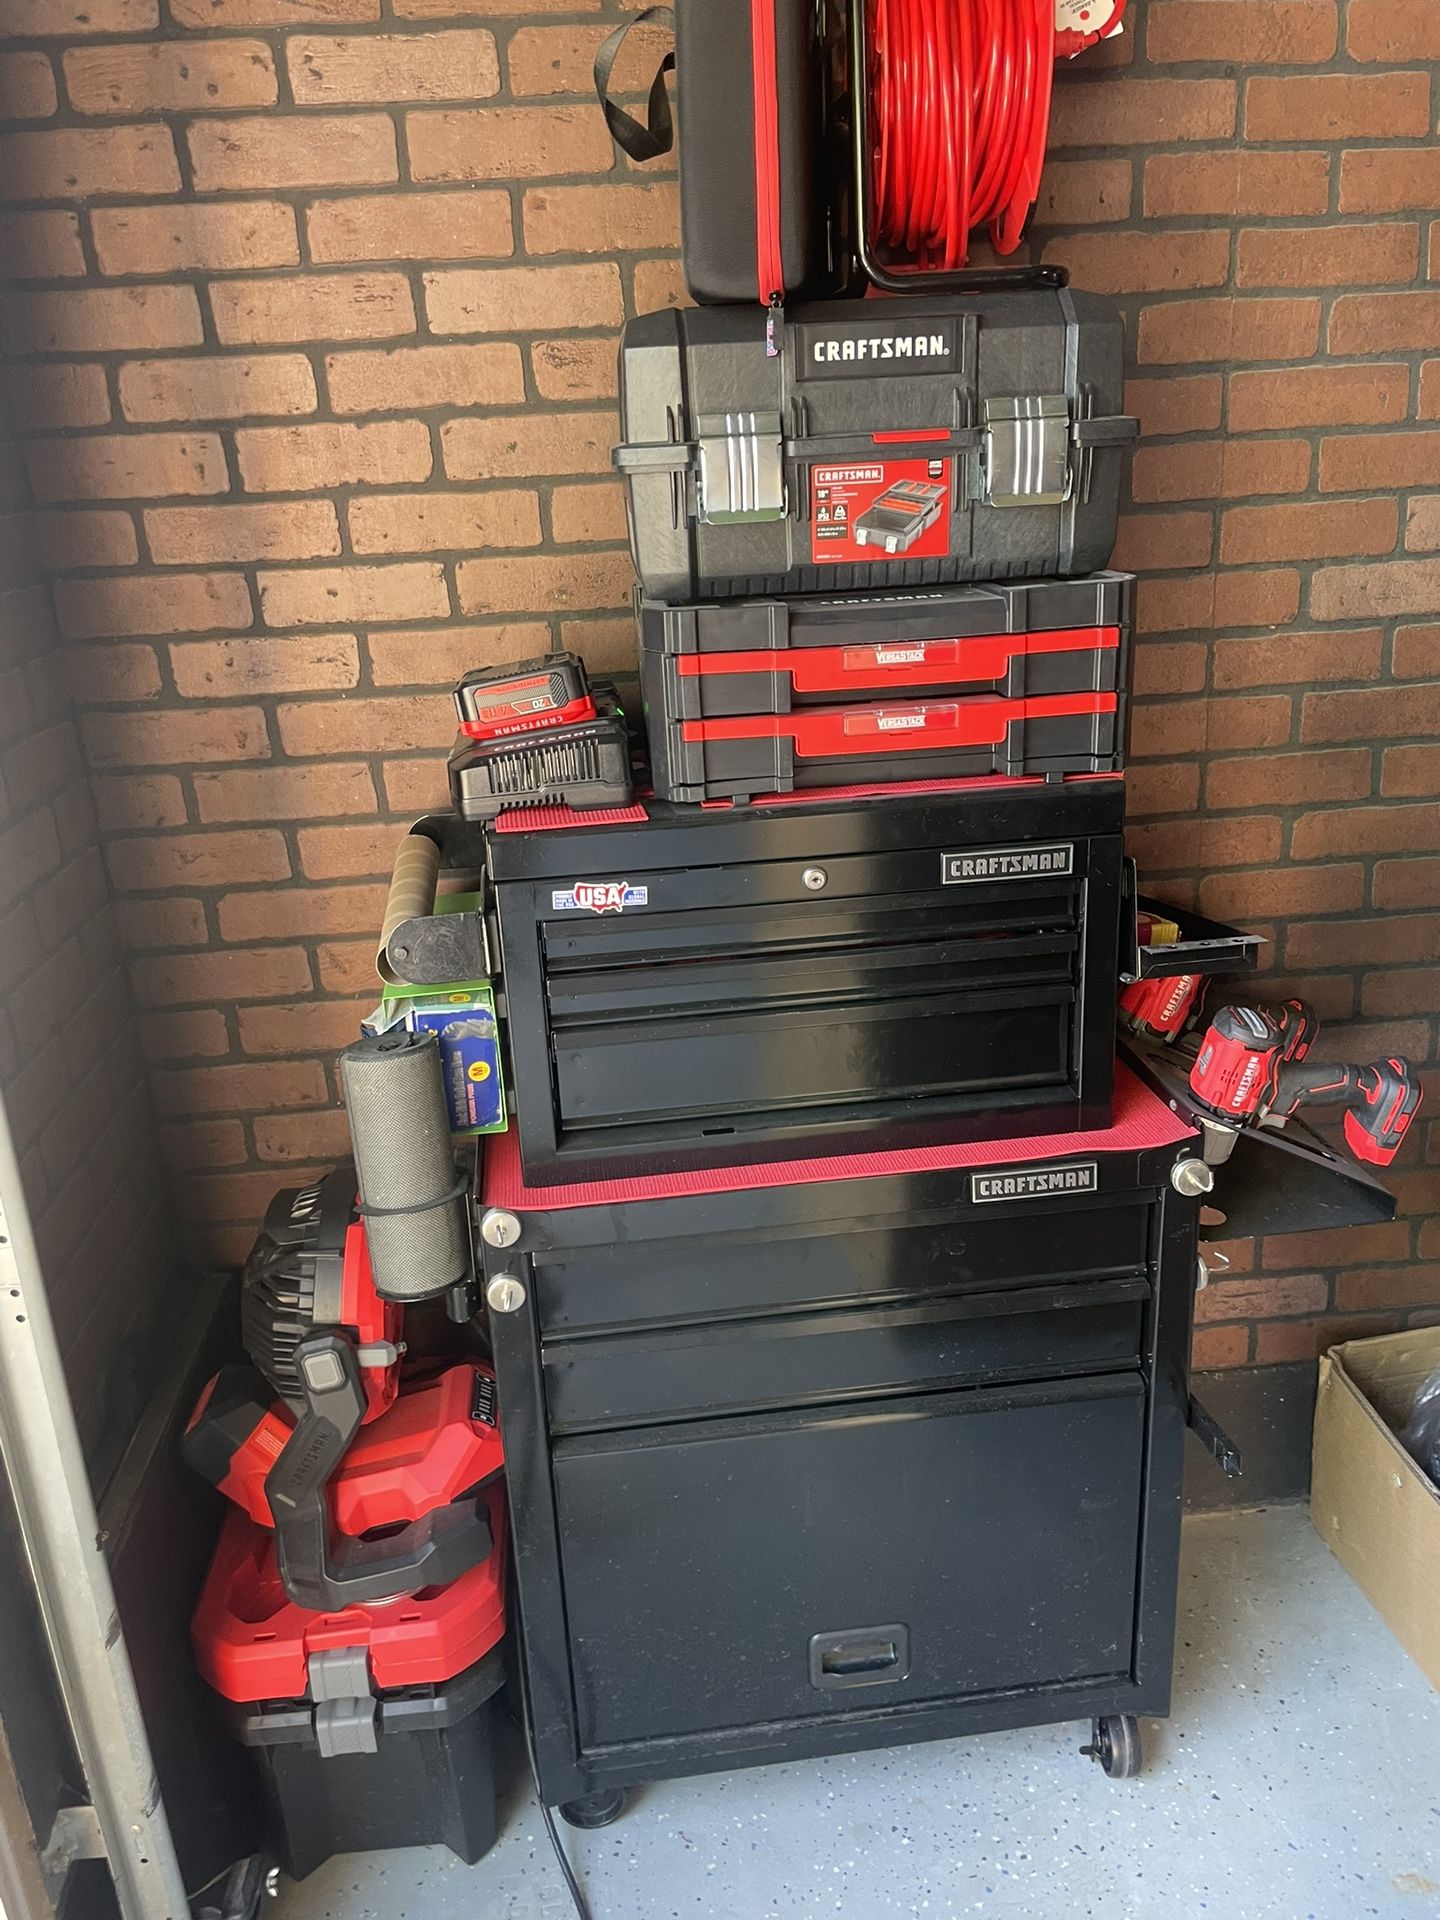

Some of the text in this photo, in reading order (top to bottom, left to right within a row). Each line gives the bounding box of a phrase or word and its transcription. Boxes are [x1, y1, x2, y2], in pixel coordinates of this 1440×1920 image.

[532, 697, 550, 709] V20
[495, 716, 563, 736] CRAFTSMAN
[950, 851, 1066, 877] CRAFTSMAN
[579, 886, 620, 906] USA
[1160, 975, 1191, 1022] CRAFTSMA
[1232, 1056, 1259, 1107] CRAFTSMAN
[980, 1170, 1090, 1196] CRAFTSMAN
